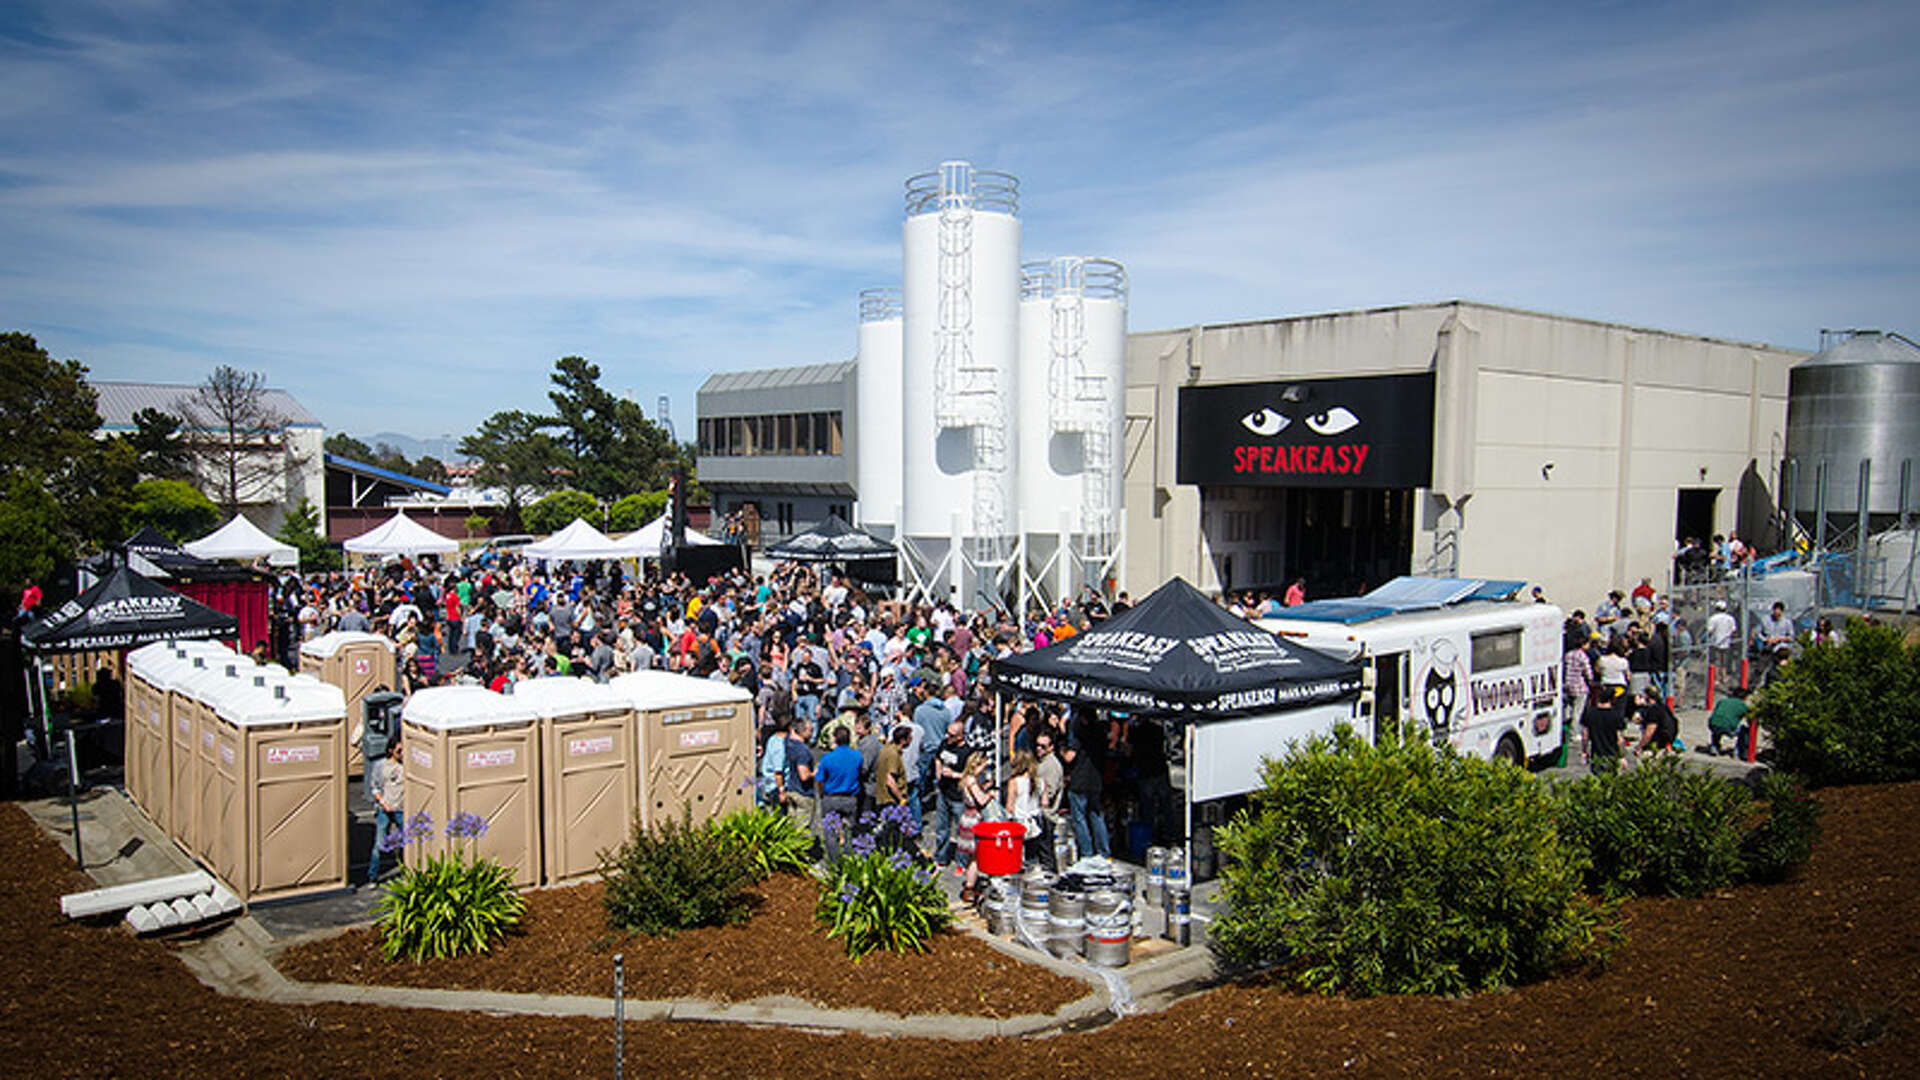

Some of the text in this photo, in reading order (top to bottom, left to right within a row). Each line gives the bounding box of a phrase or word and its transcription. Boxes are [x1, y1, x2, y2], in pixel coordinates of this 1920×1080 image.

[1234, 444, 1369, 473] SPEAKEASY
[88, 596, 181, 621] SPEAKEASY
[69, 635, 134, 648] SPEAKEASY
[1078, 632, 1180, 656] SPEAKEASY
[1187, 631, 1279, 655] SPEAKEASY
[1020, 673, 1079, 697] SPEAKEASY
[1470, 678, 1525, 715] VOODOO
[1530, 664, 1558, 695] VAN
[1219, 688, 1275, 711] SPEAKEASY
